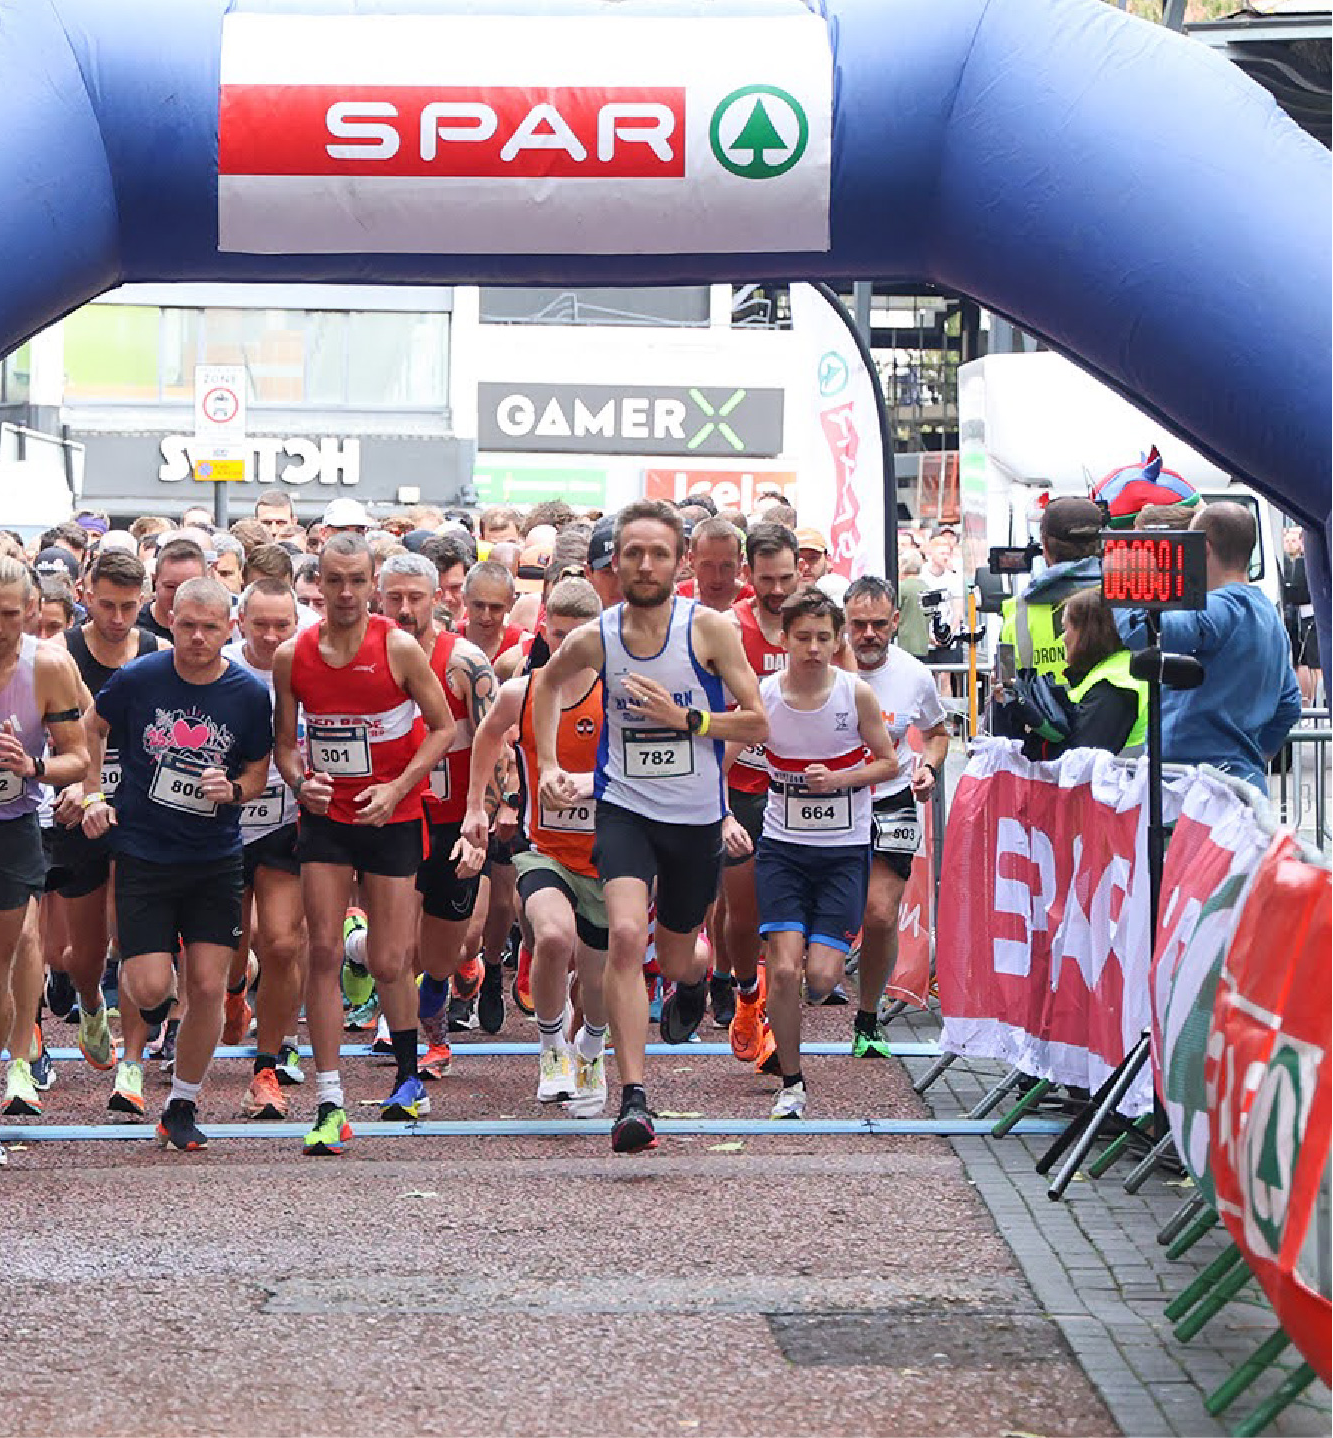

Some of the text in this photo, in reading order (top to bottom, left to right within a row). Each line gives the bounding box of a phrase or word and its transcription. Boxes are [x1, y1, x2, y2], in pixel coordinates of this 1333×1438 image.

[324, 101, 675, 162] SPAR
[763, 653, 790, 671] DA
[1033, 646, 1065, 665] DRON
[321, 749, 350, 763] 301
[639, 749, 675, 766] 782
[171, 779, 205, 800] 806
[801, 806, 835, 820] 664
